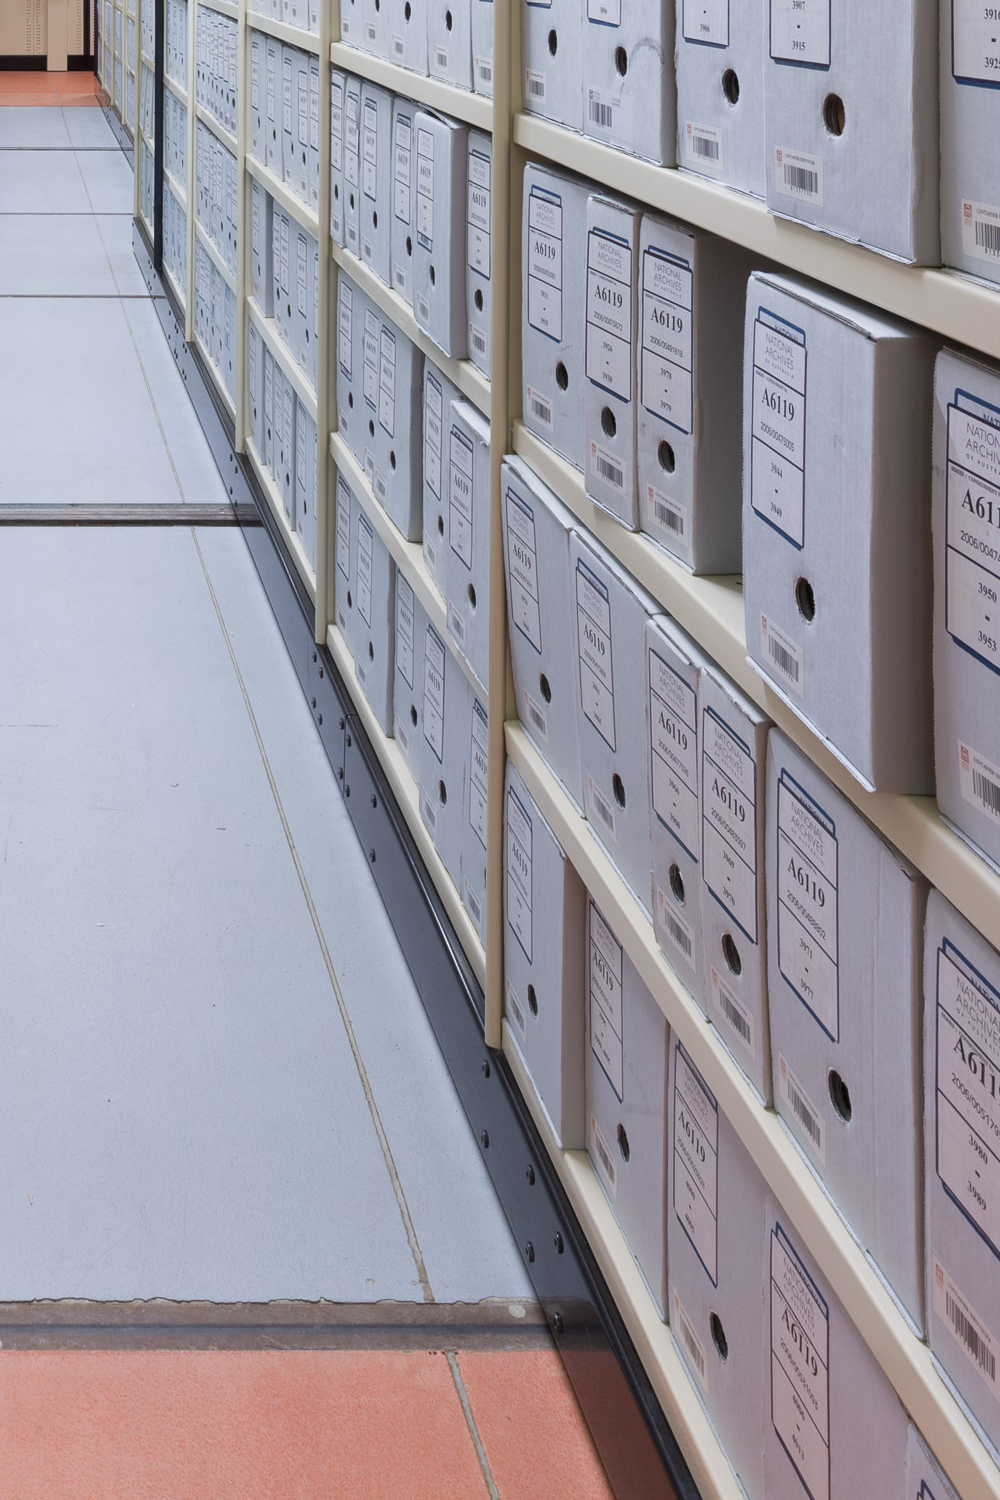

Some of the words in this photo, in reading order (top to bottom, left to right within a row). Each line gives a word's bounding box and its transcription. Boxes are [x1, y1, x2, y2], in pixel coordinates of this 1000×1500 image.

[792, 1, 805, 11] 3907
[792, 41, 805, 51] 3915
[534, 241, 556, 260] A6119
[598, 241, 622, 258] NATIONAL
[598, 252, 622, 268] ARCHIVES
[654, 273, 681, 291] ARCHIVES
[655, 262, 681, 281] NATIONAL
[594, 285, 623, 308] A6119
[651, 308, 683, 333] A6119
[765, 334, 793, 357] NATIONAL
[765, 347, 794, 370] ARCHIVES
[762, 388, 794, 421] A6119
[771, 463, 783, 479] 3944
[770, 502, 782, 517] 3949
[512, 543, 531, 569] A6119
[978, 583, 997, 602] 3950
[584, 623, 605, 656] A6119
[978, 631, 997, 651] 3953
[660, 665, 684, 694] NATIONAL
[660, 678, 684, 705] ARCHIVES
[658, 711, 688, 750] A6119
[714, 728, 742, 765] NATIONAL
[714, 740, 743, 776] ARCHIVES
[712, 778, 746, 822] A6119
[791, 800, 823, 843] NATIONAL
[791, 814, 823, 855] ARCHIVES
[512, 842, 528, 877] A6119
[788, 857, 825, 907] A6119
[800, 938, 813, 959] 3971
[593, 950, 613, 991] A6119
[800, 979, 814, 1001] 3977
[957, 977, 1000, 1027] NATIONA
[956, 994, 1000, 1045] ARCHIVE
[954, 1037, 1000, 1105] A611
[951, 1072, 1000, 1138] 2006/005179
[678, 1111, 705, 1163] A6119
[968, 1134, 988, 1165] 3980
[967, 1180, 987, 1211] 3989
[781, 1309, 818, 1377] A6119
